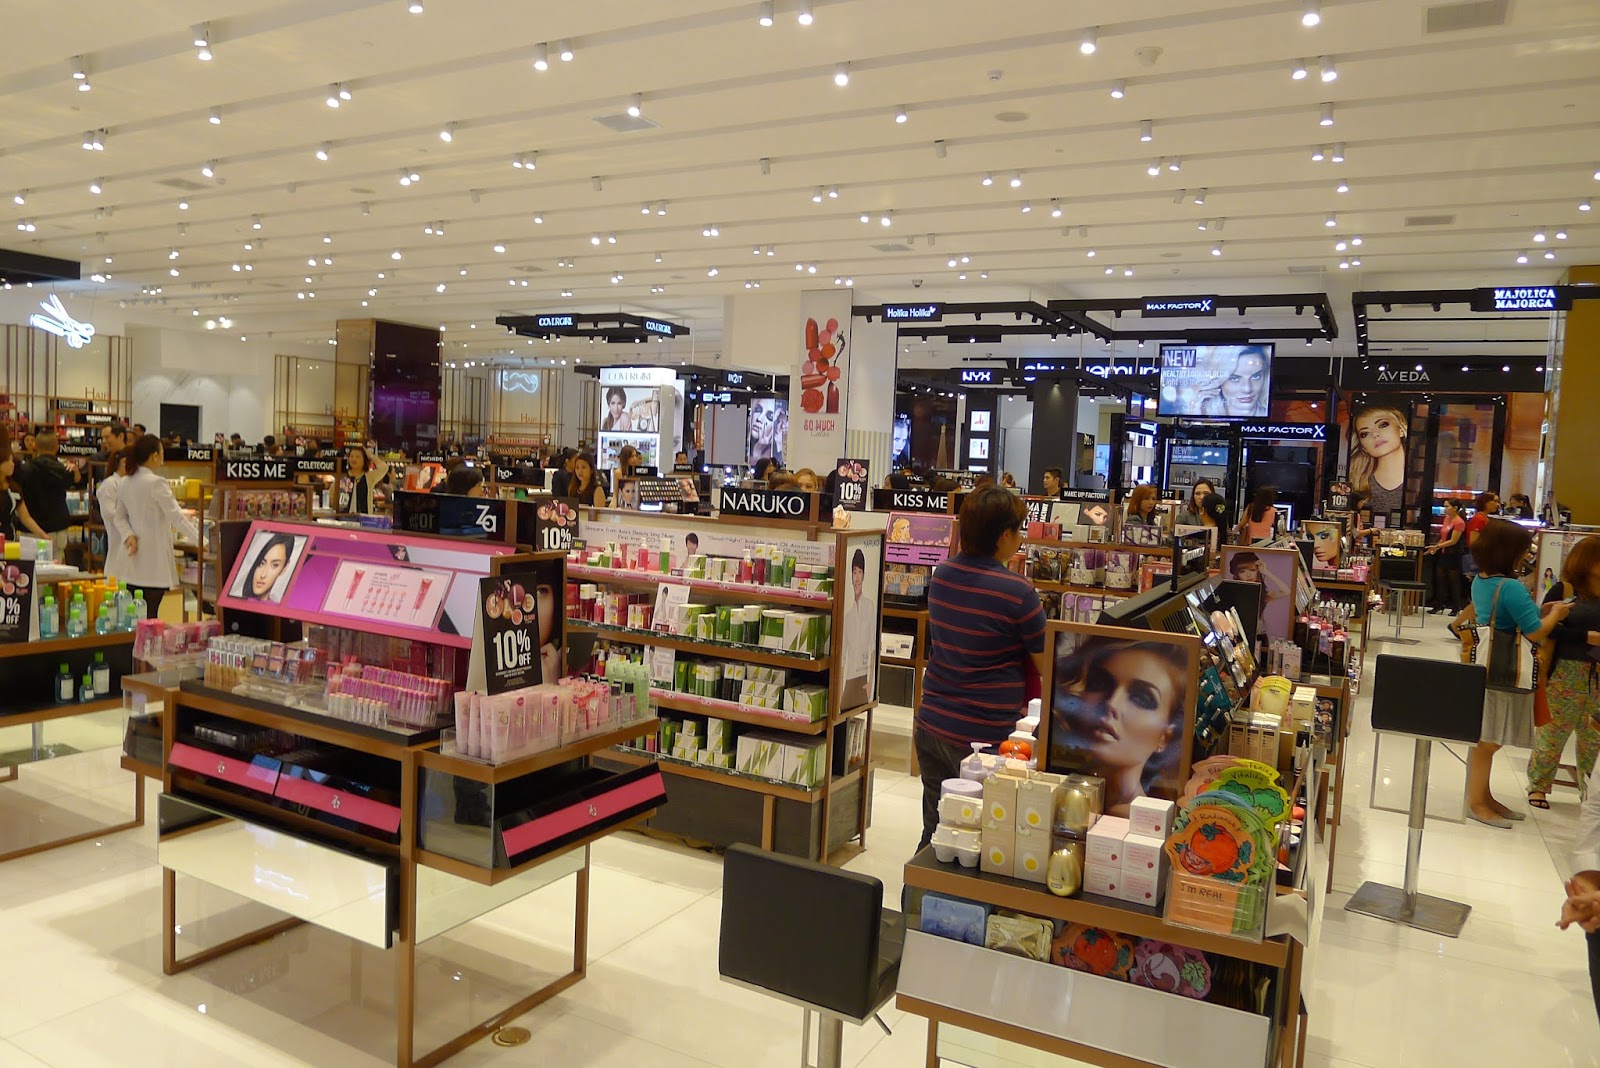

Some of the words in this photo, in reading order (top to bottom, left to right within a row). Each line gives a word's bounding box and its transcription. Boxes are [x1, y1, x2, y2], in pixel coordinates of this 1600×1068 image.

[1493, 288, 1556, 299] MAJOLICA
[1146, 303, 1166, 311] MAX
[1494, 298, 1553, 309] MAJORCA
[887, 307, 909, 318] Holika
[909, 307, 932, 318] Holika
[538, 317, 573, 327] COVERGIRL
[645, 320, 672, 335] COVERGIRL
[1163, 349, 1195, 367] NEW
[608, 372, 652, 381] COVERGIRL
[961, 370, 991, 383] NYX
[1377, 370, 1430, 382] AVEDA
[702, 393, 732, 402] BYS
[815, 420, 835, 432] MUCH
[1240, 425, 1266, 433] MAX
[60, 444, 98, 455] Neutrogena
[187, 450, 211, 460] FACE
[226, 462, 260, 478] KISS
[263, 463, 287, 478] ME
[297, 460, 335, 471] CELETEQUE
[840, 481, 862, 501] 10%
[1063, 490, 1077, 498] MAKE
[1077, 491, 1085, 499] UP
[1085, 491, 1107, 500] FACTORY
[893, 493, 924, 508] KISS
[926, 495, 948, 509] ME
[475, 504, 497, 534] Za
[541, 526, 572, 550] 10%
[560, 541, 571, 550] OFF
[5, 614, 20, 625] OFF
[493, 628, 532, 671] 10%
[518, 651, 532, 667] OFF
[1231, 771, 1264, 784] Vitality
[1199, 812, 1236, 828] Radiance
[1179, 883, 1197, 895] I'm
[1199, 887, 1224, 901] REAL
